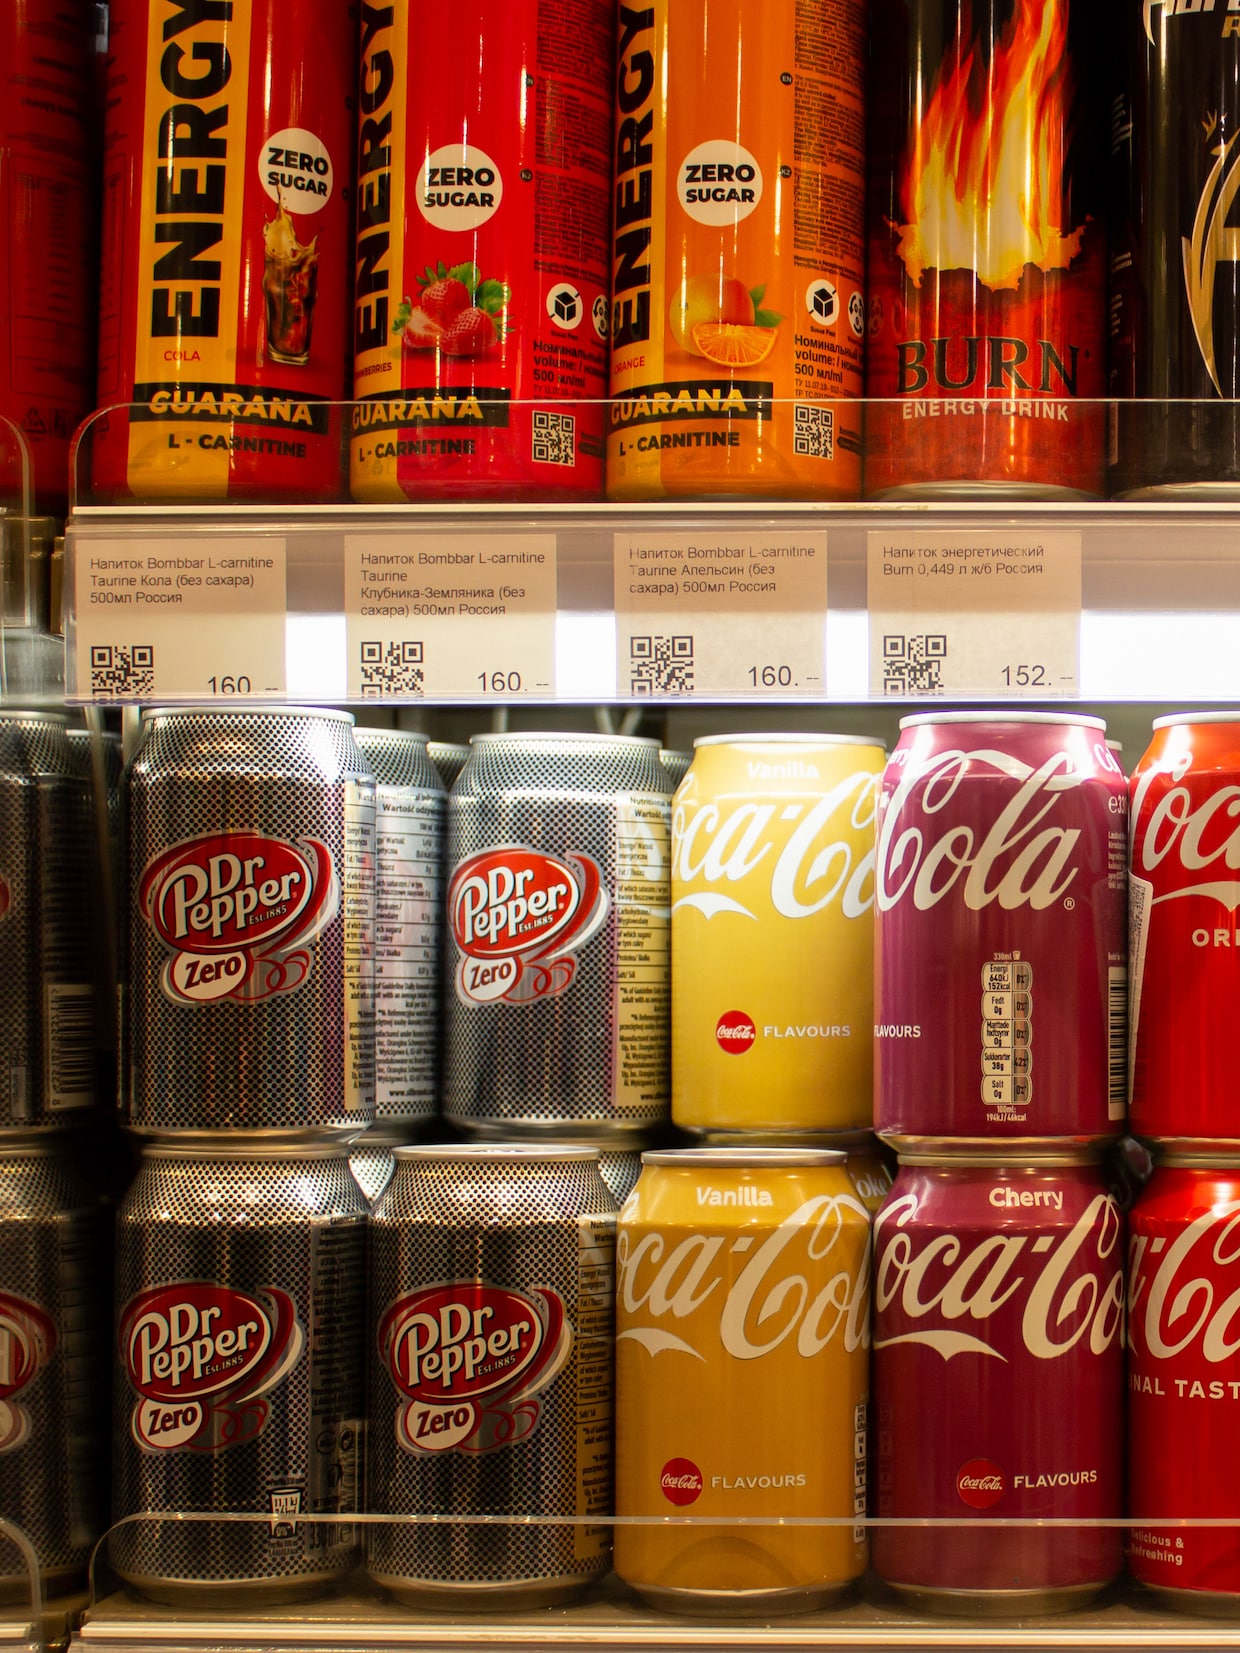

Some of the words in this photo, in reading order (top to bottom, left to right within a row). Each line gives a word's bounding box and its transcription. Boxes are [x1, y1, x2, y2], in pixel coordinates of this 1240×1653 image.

[150, 0, 234, 339] ENERGY
[267, 146, 329, 177] ZERO
[424, 167, 495, 188] ZERO
[612, 3, 656, 351] ENERGY
[685, 163, 755, 184] ZERO
[267, 171, 328, 198] SUGAR
[424, 190, 494, 208] SUGAR
[686, 187, 755, 204] SUGAR
[163, 350, 200, 362] COLA
[613, 355, 646, 375] ORANGE
[795, 350, 835, 366] volume:
[896, 335, 1079, 396] BURN
[795, 364, 814, 377] 500
[148, 390, 313, 427] GUARANA
[352, 394, 484, 431] GUARANA
[610, 389, 748, 426] GUARANA
[902, 400, 990, 420] ENERGY
[1002, 400, 1069, 422] DRINK
[361, 553, 415, 565] Напиток
[418, 553, 475, 565] Bombbar
[479, 552, 545, 564] L-carnitine
[629, 547, 684, 559] Напиток
[687, 547, 745, 559] Bombbar
[749, 546, 815, 558] L-carnitine
[941, 545, 1044, 560] энергетический
[90, 558, 144, 570] Напиток
[147, 557, 205, 569] Bombbar
[208, 557, 274, 569] L-carnitine
[629, 564, 677, 576] Taurine
[681, 564, 744, 575] Апельсин
[748, 563, 775, 577] (без
[883, 563, 914, 575] Burn
[917, 563, 955, 577] 0,449
[970, 563, 992, 575] ж/б
[996, 562, 1043, 574] Россия
[90, 575, 137, 587] Taurine
[140, 575, 172, 586] Кола
[176, 574, 202, 588] (без
[205, 574, 255, 588] сахара)
[361, 570, 408, 582] Taurine
[90, 592, 132, 604] 500мл
[136, 592, 183, 603] Россия
[361, 587, 495, 601] Клубника-Земляника
[499, 586, 526, 601] (без
[629, 581, 679, 595] сахара)
[683, 581, 725, 593] 500мл
[729, 581, 776, 592] Россия
[360, 604, 410, 619] сахара)
[413, 604, 455, 616] 500мл
[459, 604, 506, 615] Россия
[747, 762, 818, 780] Vanilla
[208, 854, 264, 897] Dr
[488, 866, 533, 901] Dr
[169, 864, 300, 939] Pepper
[459, 875, 567, 944] Pepper
[184, 956, 240, 990] Zero
[471, 961, 511, 989] Zero
[764, 1025, 850, 1038] FLAVOURS
[696, 1187, 773, 1206] Vanilla
[989, 1186, 1064, 1210] Cherry
[170, 1304, 220, 1343] Dr
[439, 1304, 493, 1343] Dr
[137, 1312, 258, 1387] Pepper
[404, 1315, 530, 1388] Pepper
[149, 1404, 198, 1435] Zero
[416, 1404, 470, 1437] Zero
[711, 1474, 806, 1489] FLAVOURS
[1014, 1470, 1098, 1489] FLAVOURS
